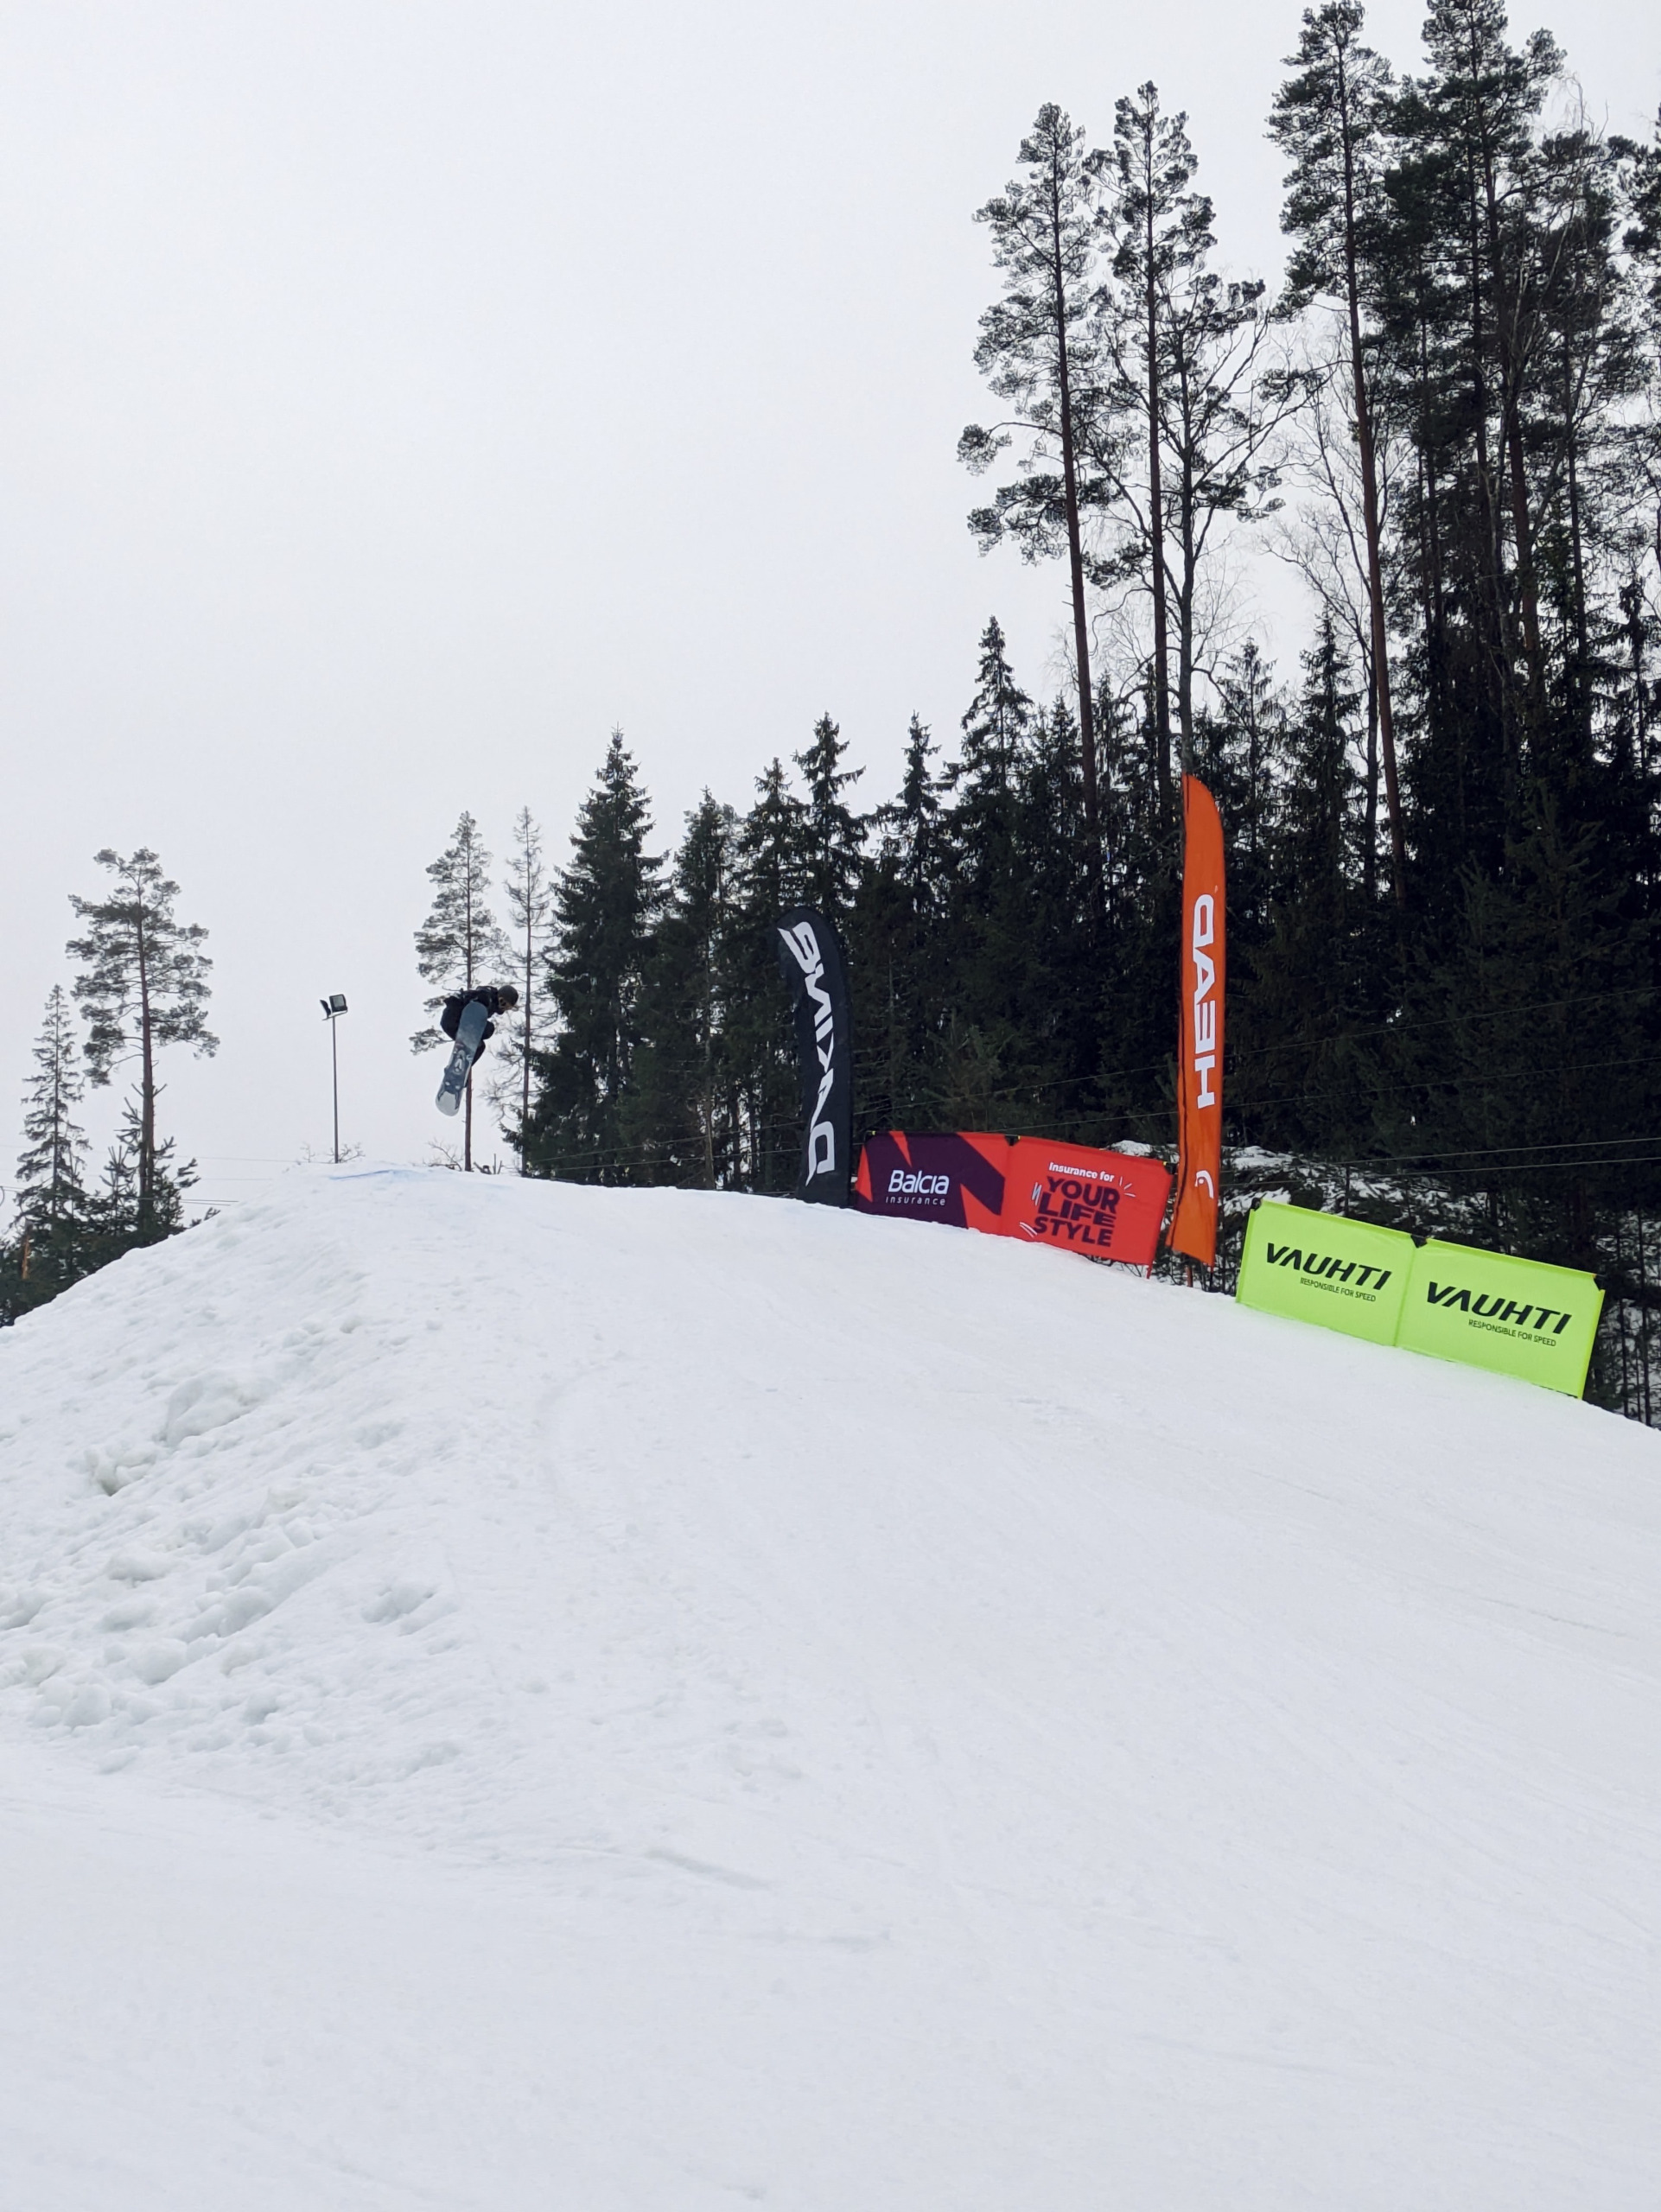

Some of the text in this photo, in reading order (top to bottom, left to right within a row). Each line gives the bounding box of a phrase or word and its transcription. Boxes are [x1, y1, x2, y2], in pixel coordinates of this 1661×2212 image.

[888, 1169, 950, 1194] Balcia
[1048, 1162, 1116, 1182] Insurance for
[886, 1196, 945, 1205] insurance
[1047, 1175, 1121, 1214] YOUR
[1038, 1192, 1117, 1228] LIFE
[1033, 1216, 1113, 1247] STYLE
[1266, 1243, 1392, 1290] VAUHTI
[1300, 1277, 1377, 1302] RESPONSIBLE FOR SPEED
[1427, 1281, 1573, 1335] VAUHTI
[1468, 1319, 1556, 1346] RESPONSIBLE FOR SPEED
